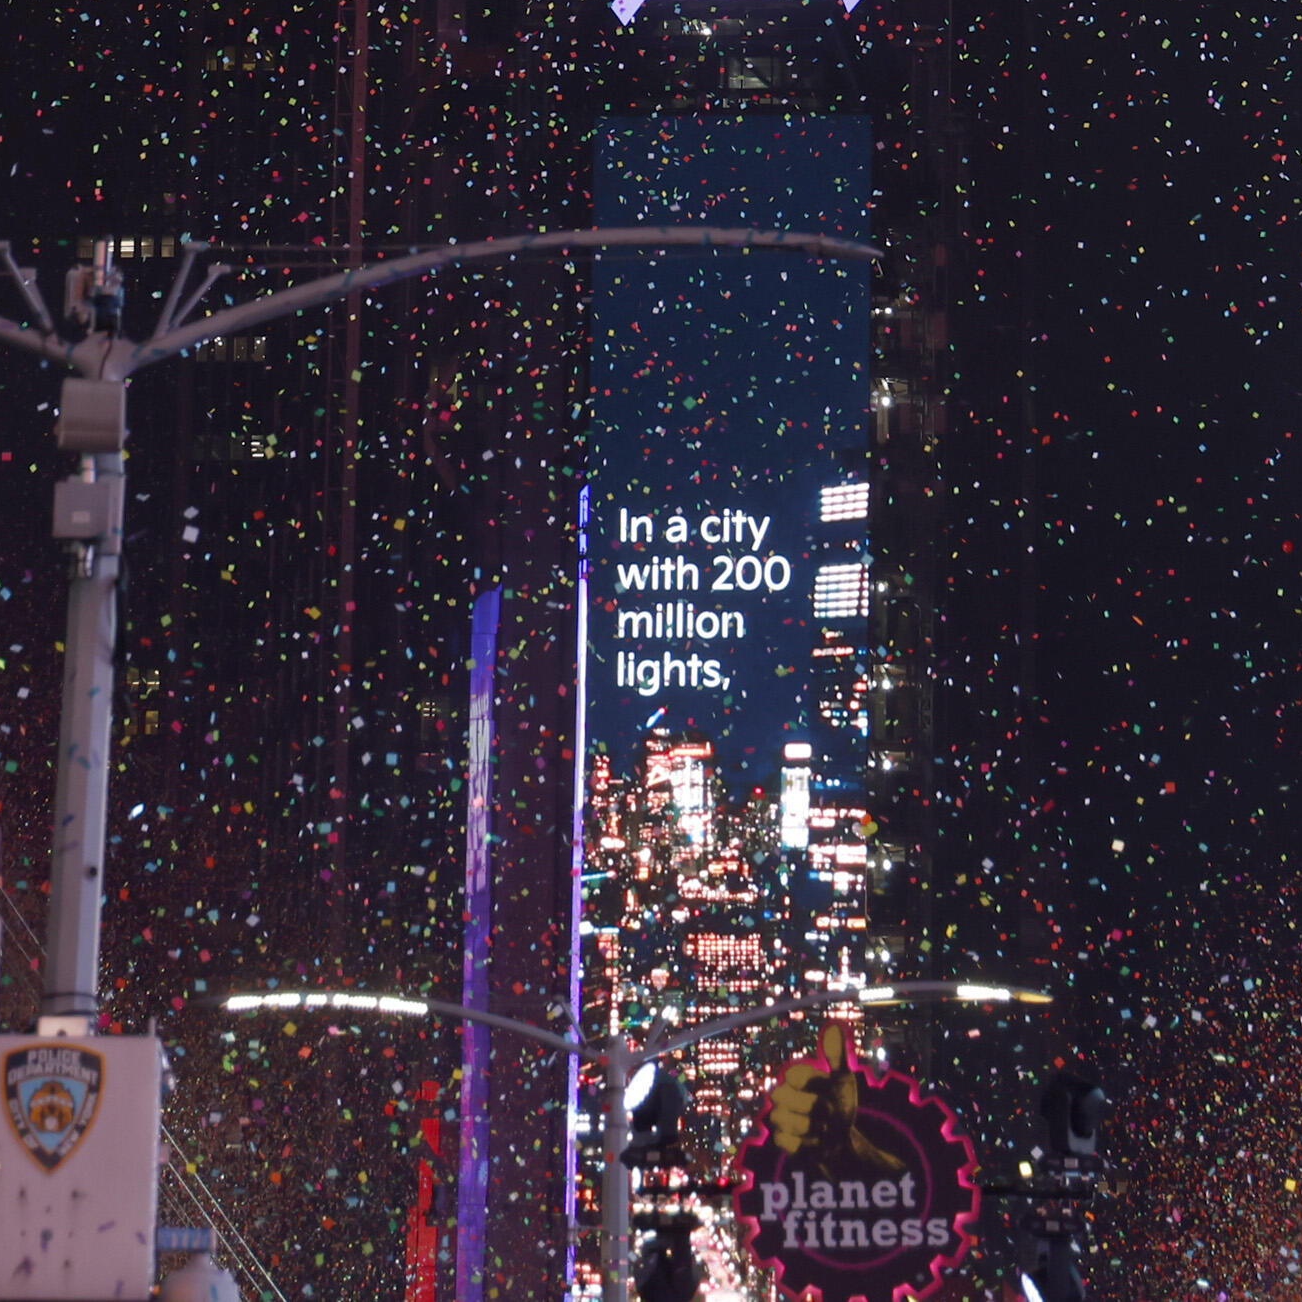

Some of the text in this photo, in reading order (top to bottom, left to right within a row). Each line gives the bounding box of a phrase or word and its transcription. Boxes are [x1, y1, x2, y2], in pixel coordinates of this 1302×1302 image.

[619, 507, 771, 552] In a city
[617, 555, 792, 591] with 200
[617, 602, 744, 639] million
[617, 651, 731, 696] lights,
[760, 1172, 917, 1220] planet
[783, 1208, 950, 1249] fitness
